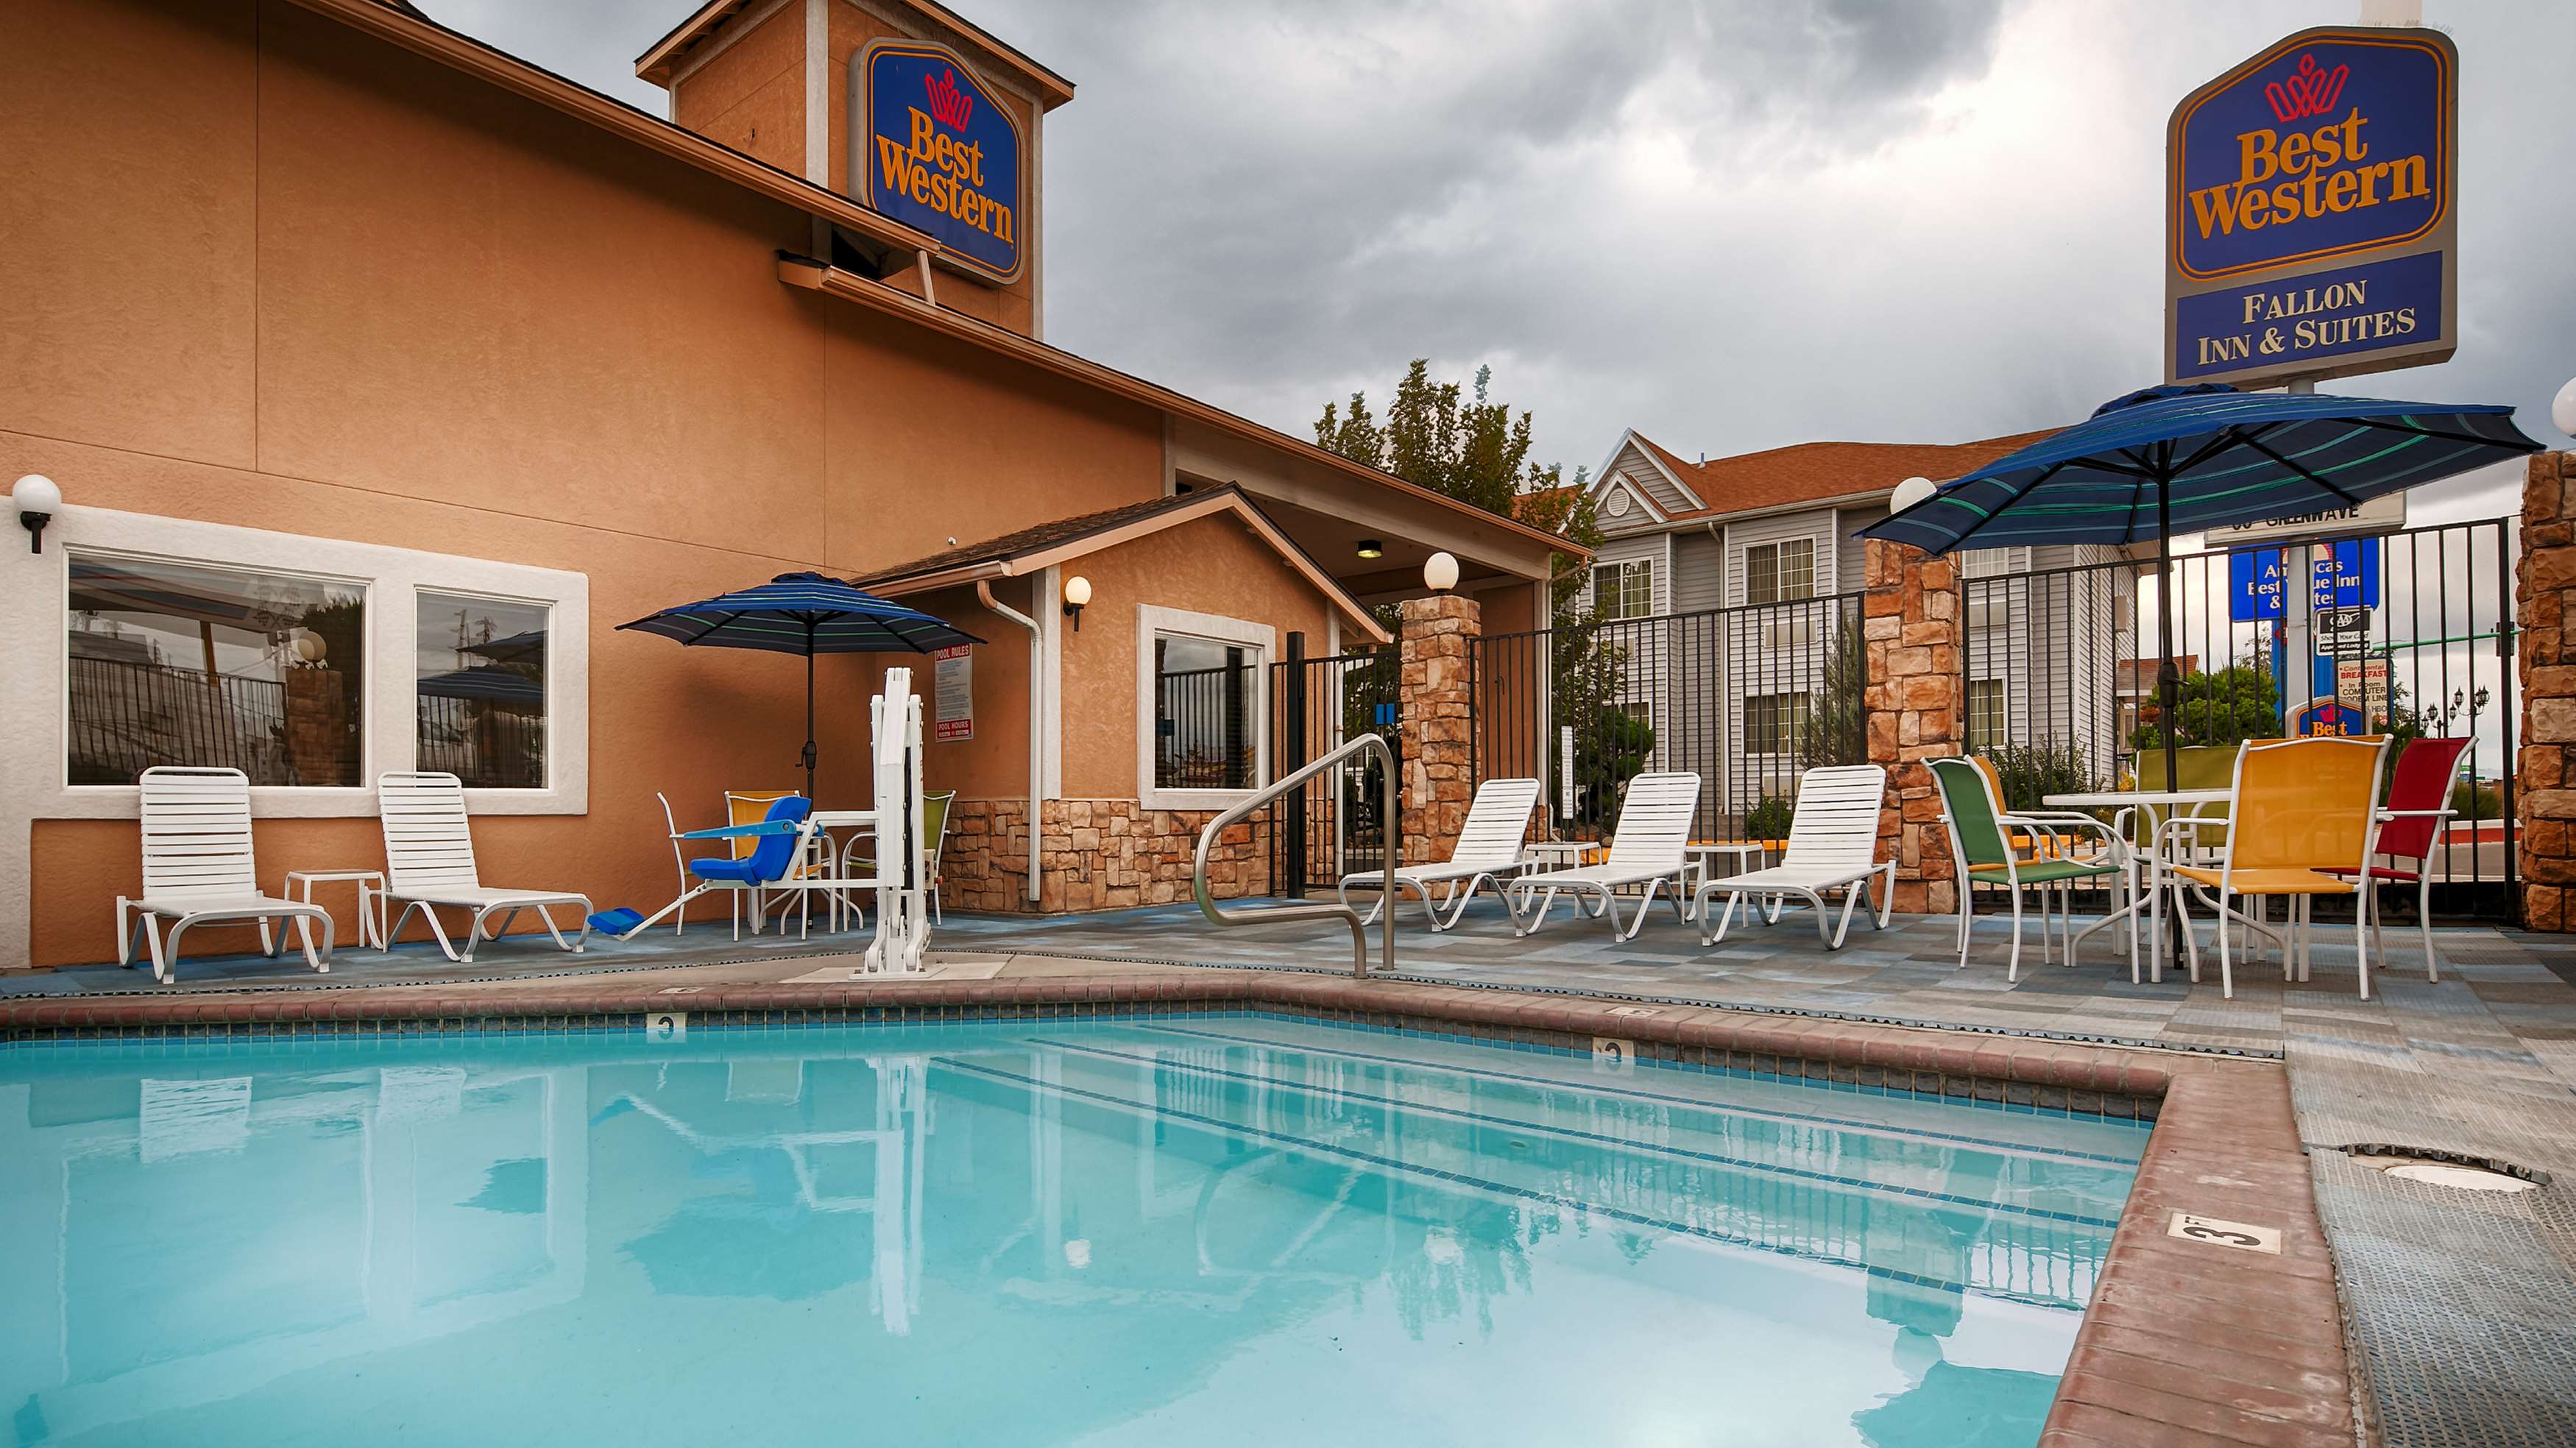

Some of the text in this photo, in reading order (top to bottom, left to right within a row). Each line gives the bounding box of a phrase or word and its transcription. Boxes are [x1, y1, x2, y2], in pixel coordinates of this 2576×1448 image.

[907, 106, 983, 187] Best
[2237, 107, 2368, 185] Best
[876, 134, 1013, 244] Western
[2189, 155, 2430, 239] Western
[2243, 280, 2368, 324] FALLON
[2198, 308, 2416, 366] INN & SUITES
[937, 645, 969, 660] POOL RULES
[2343, 686, 2386, 695] COMUTER
[951, 720, 969, 729] HOURS
[2183, 1227, 2261, 1246] 3
